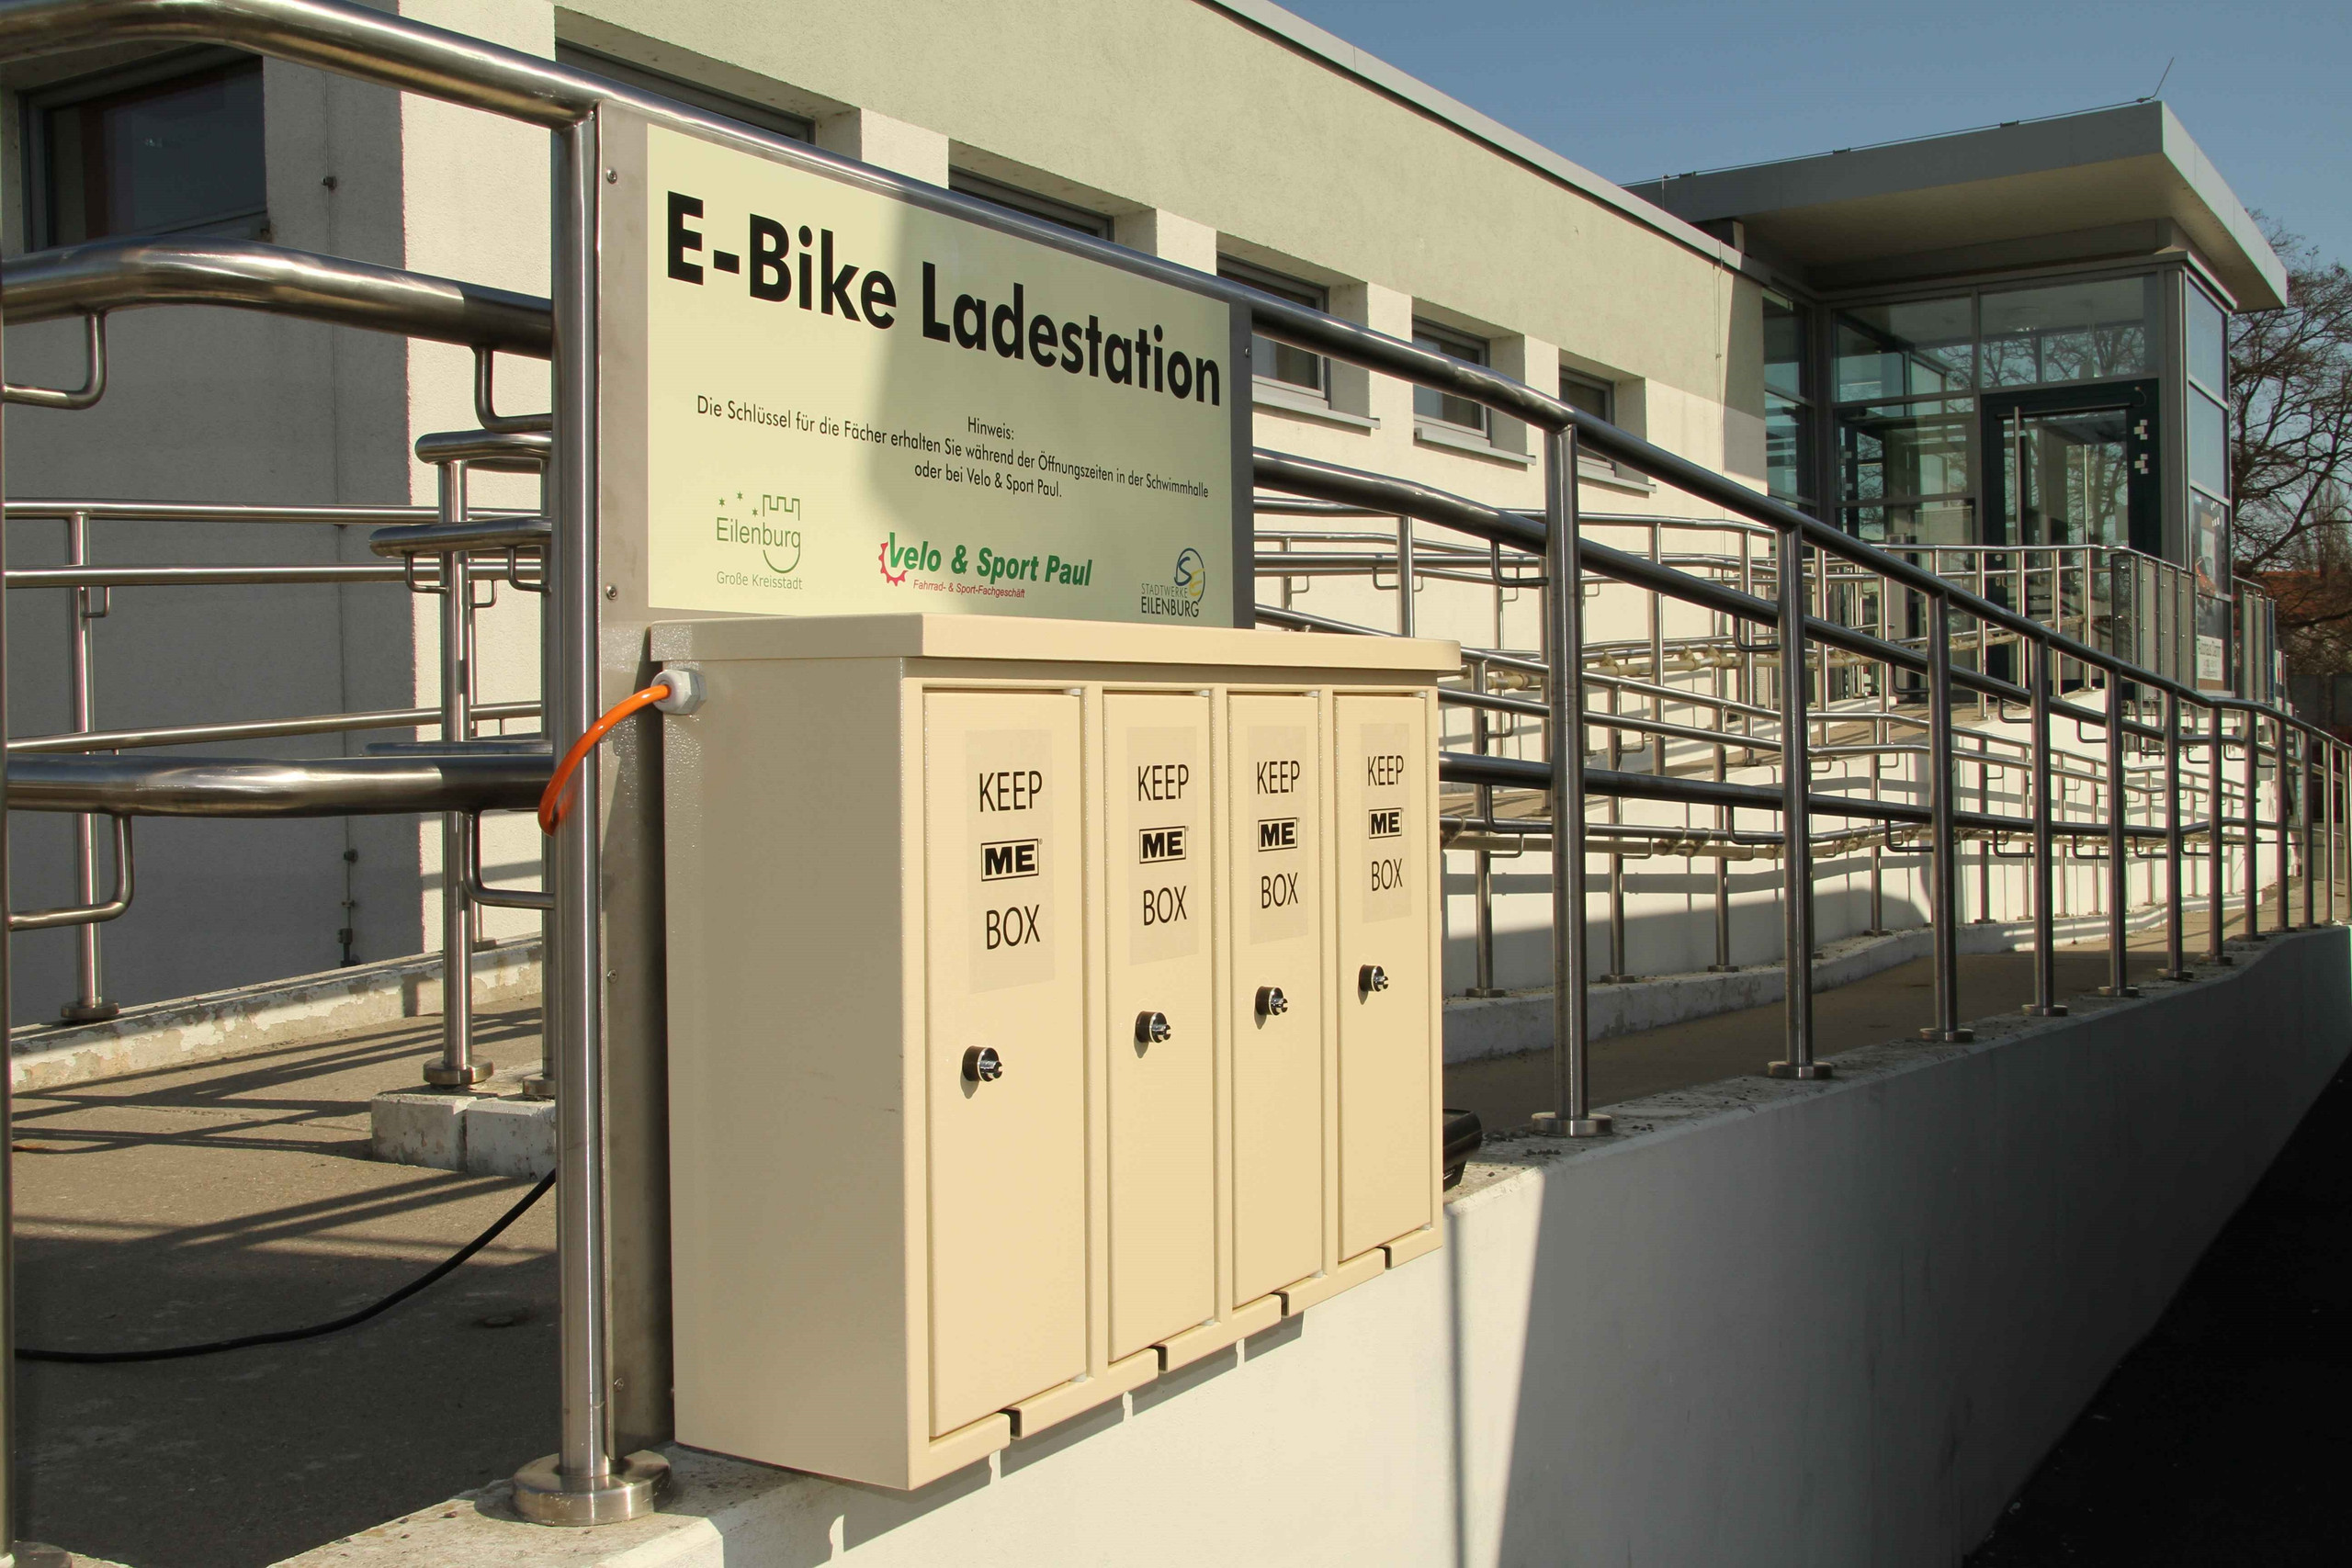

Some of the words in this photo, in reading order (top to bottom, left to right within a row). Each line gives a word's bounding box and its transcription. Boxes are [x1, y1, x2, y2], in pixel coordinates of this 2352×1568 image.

[667, 190, 897, 330] E-Bike
[922, 261, 1220, 407] Ladestation
[967, 416, 1014, 441] Hinweis:
[697, 395, 722, 417] Die
[727, 400, 791, 429] Schlüssel
[796, 412, 815, 433] für
[819, 416, 840, 436] die
[844, 421, 887, 445] Fächer
[890, 430, 941, 454] erhalten
[944, 438, 962, 457] Sie
[965, 444, 1013, 466] während
[1017, 450, 1035, 468] der
[1038, 451, 1114, 482] Öffnungszeiten
[1116, 468, 1125, 485] in
[1128, 470, 1144, 488] der
[1146, 473, 1209, 499] Schwimmhalle
[914, 461, 942, 479] oder
[945, 464, 963, 483] bei
[967, 467, 991, 487] Velo
[995, 473, 1002, 489] &
[1006, 474, 1035, 495] Sport
[1037, 479, 1062, 498] Paul.
[717, 517, 800, 573] Eilenburg
[889, 532, 942, 572] Velo
[951, 544, 967, 575] &
[977, 547, 1039, 584] Sport
[1045, 555, 1092, 586] Paul
[717, 571, 748, 586] Große
[752, 574, 803, 590] Kreisstadt
[913, 579, 946, 592] Fahrrad-
[948, 581, 955, 592] &
[956, 582, 1025, 598] Sport-Fachgeschäft
[1141, 583, 1188, 598] STADTWERKE
[1141, 596, 1199, 617] EILENBURG
[1137, 764, 1189, 801] KEEP
[1257, 761, 1300, 795] KEEP
[1367, 755, 1404, 786] KEEP
[979, 770, 1043, 812] KEEP
[1261, 873, 1298, 908] BOX
[1372, 858, 1403, 891] BOX
[1143, 886, 1187, 926] BOX
[986, 904, 1040, 950] BOX
